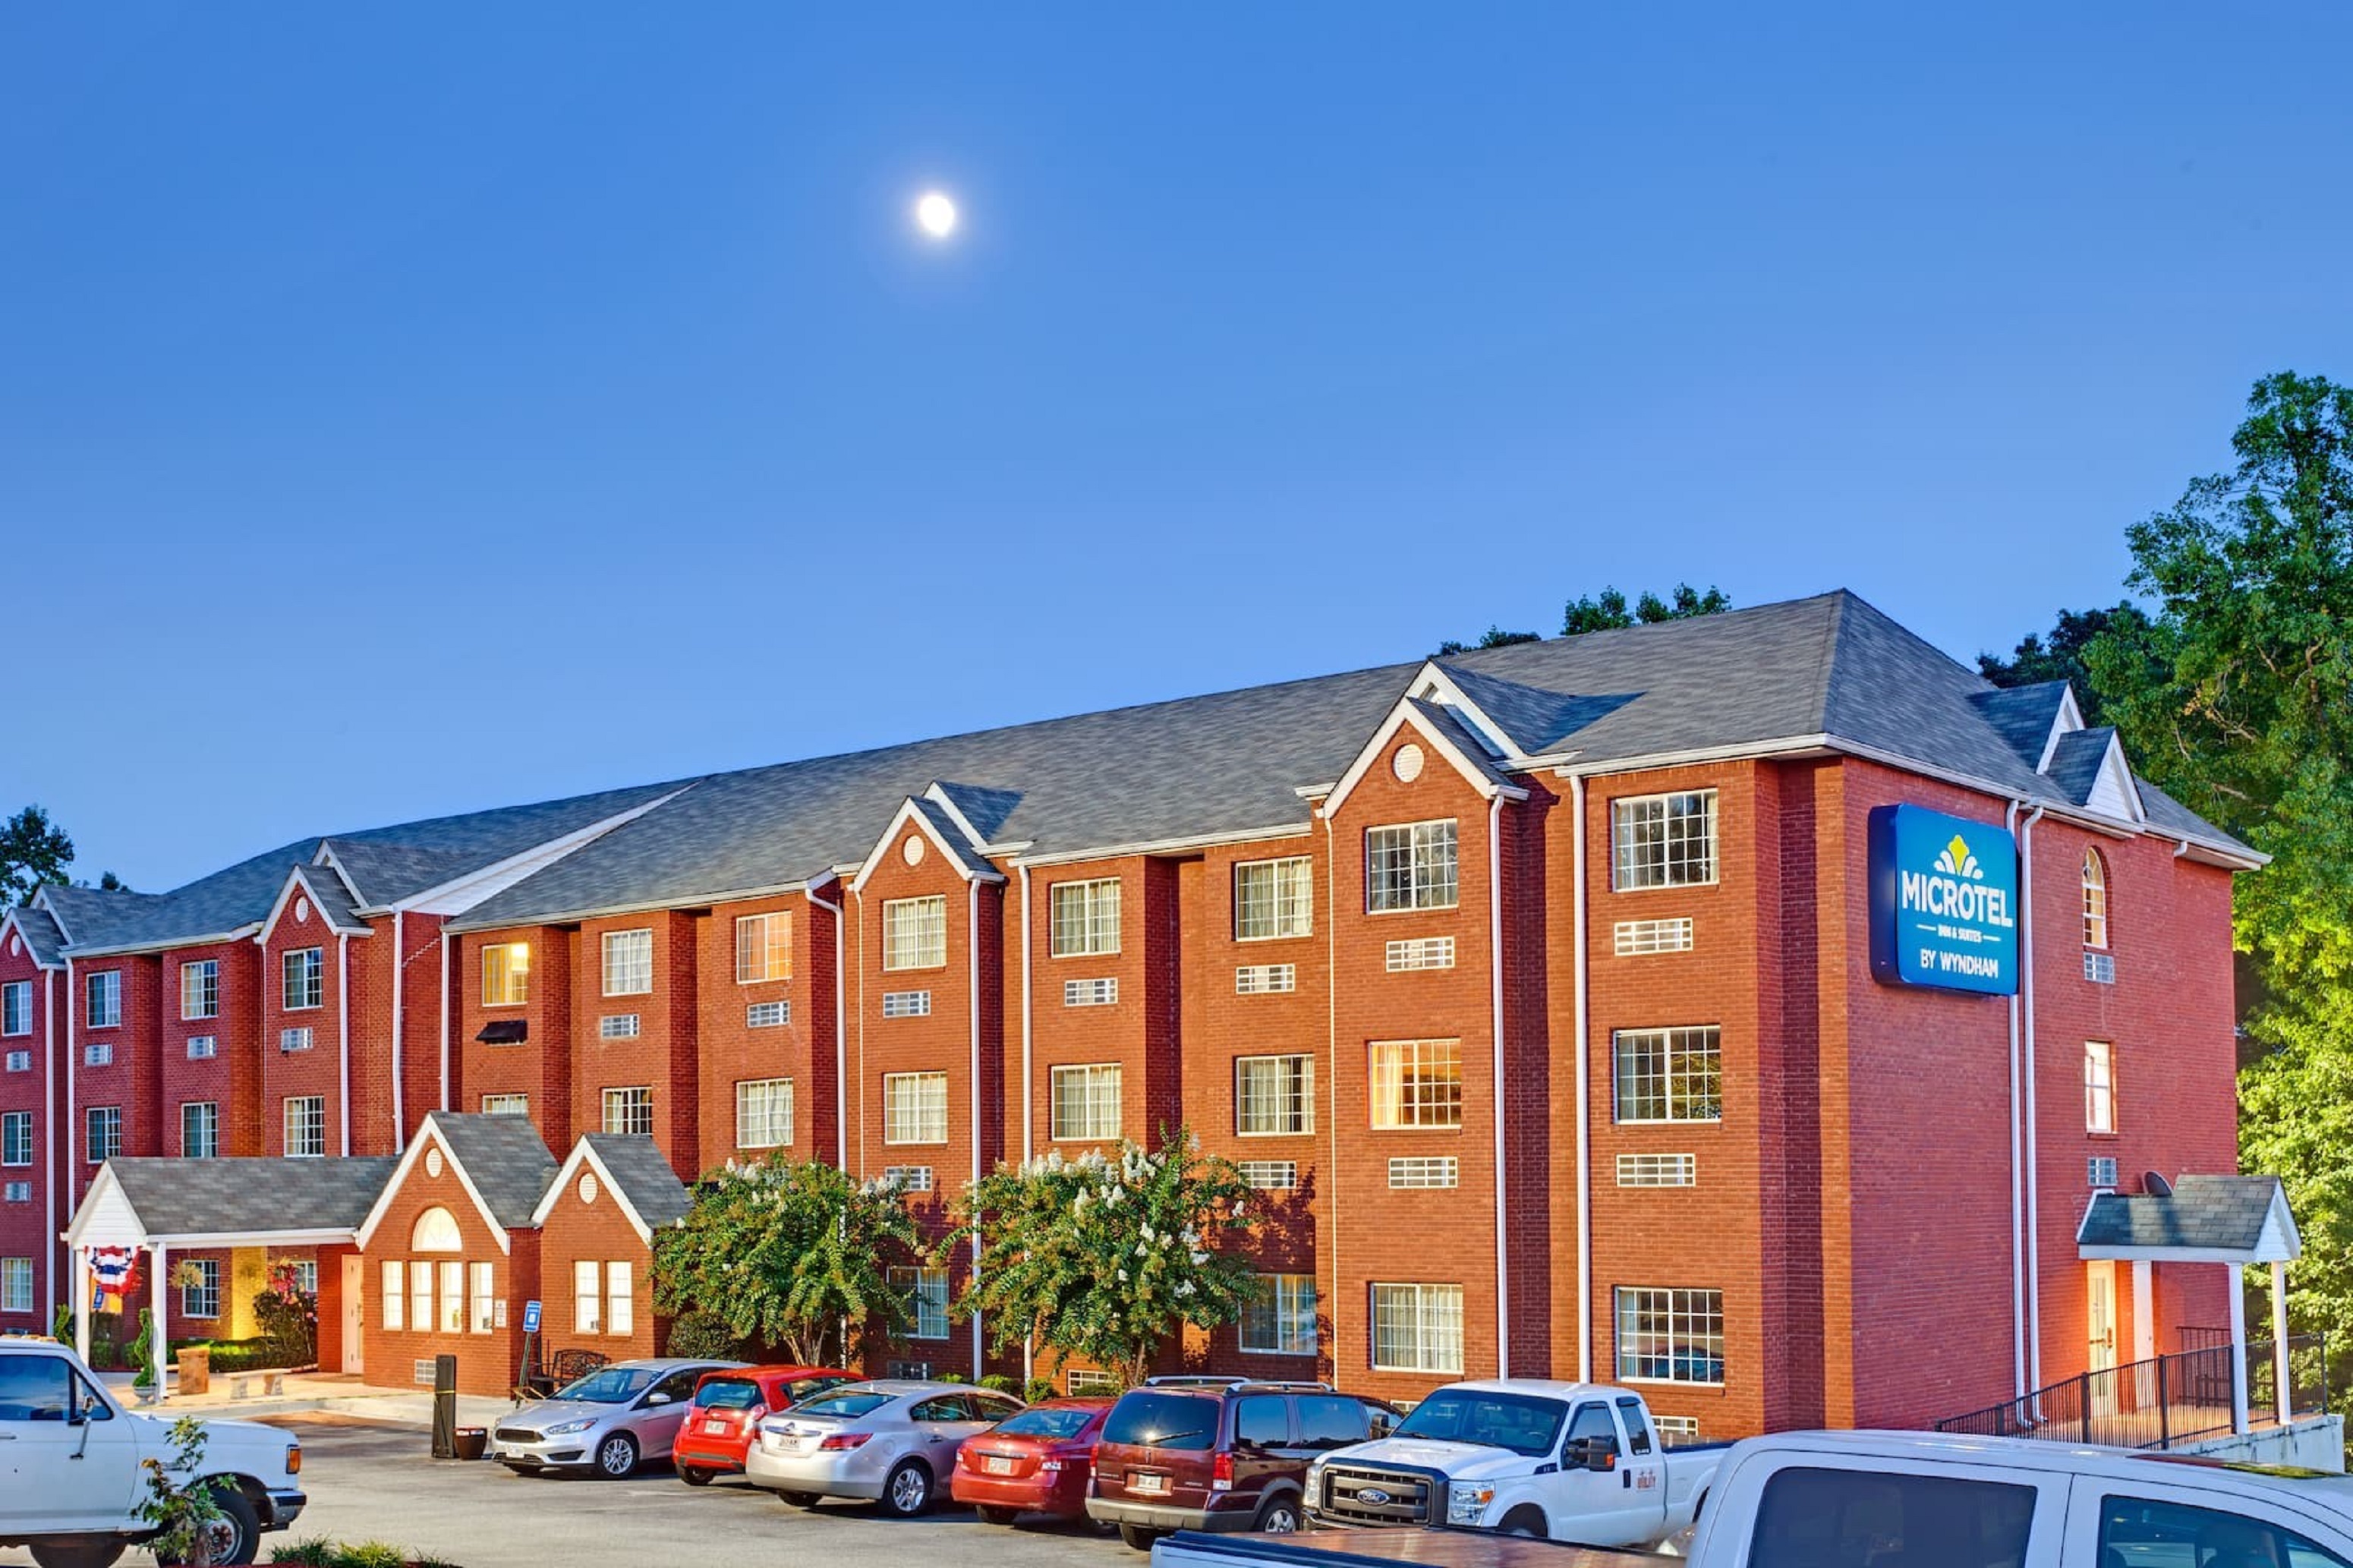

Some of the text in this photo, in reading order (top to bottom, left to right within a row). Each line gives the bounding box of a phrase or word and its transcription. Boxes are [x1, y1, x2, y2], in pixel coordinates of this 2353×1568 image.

[1901, 871, 2013, 927] MICROTEL
[1920, 948, 1999, 978] BY WYNDHAM
